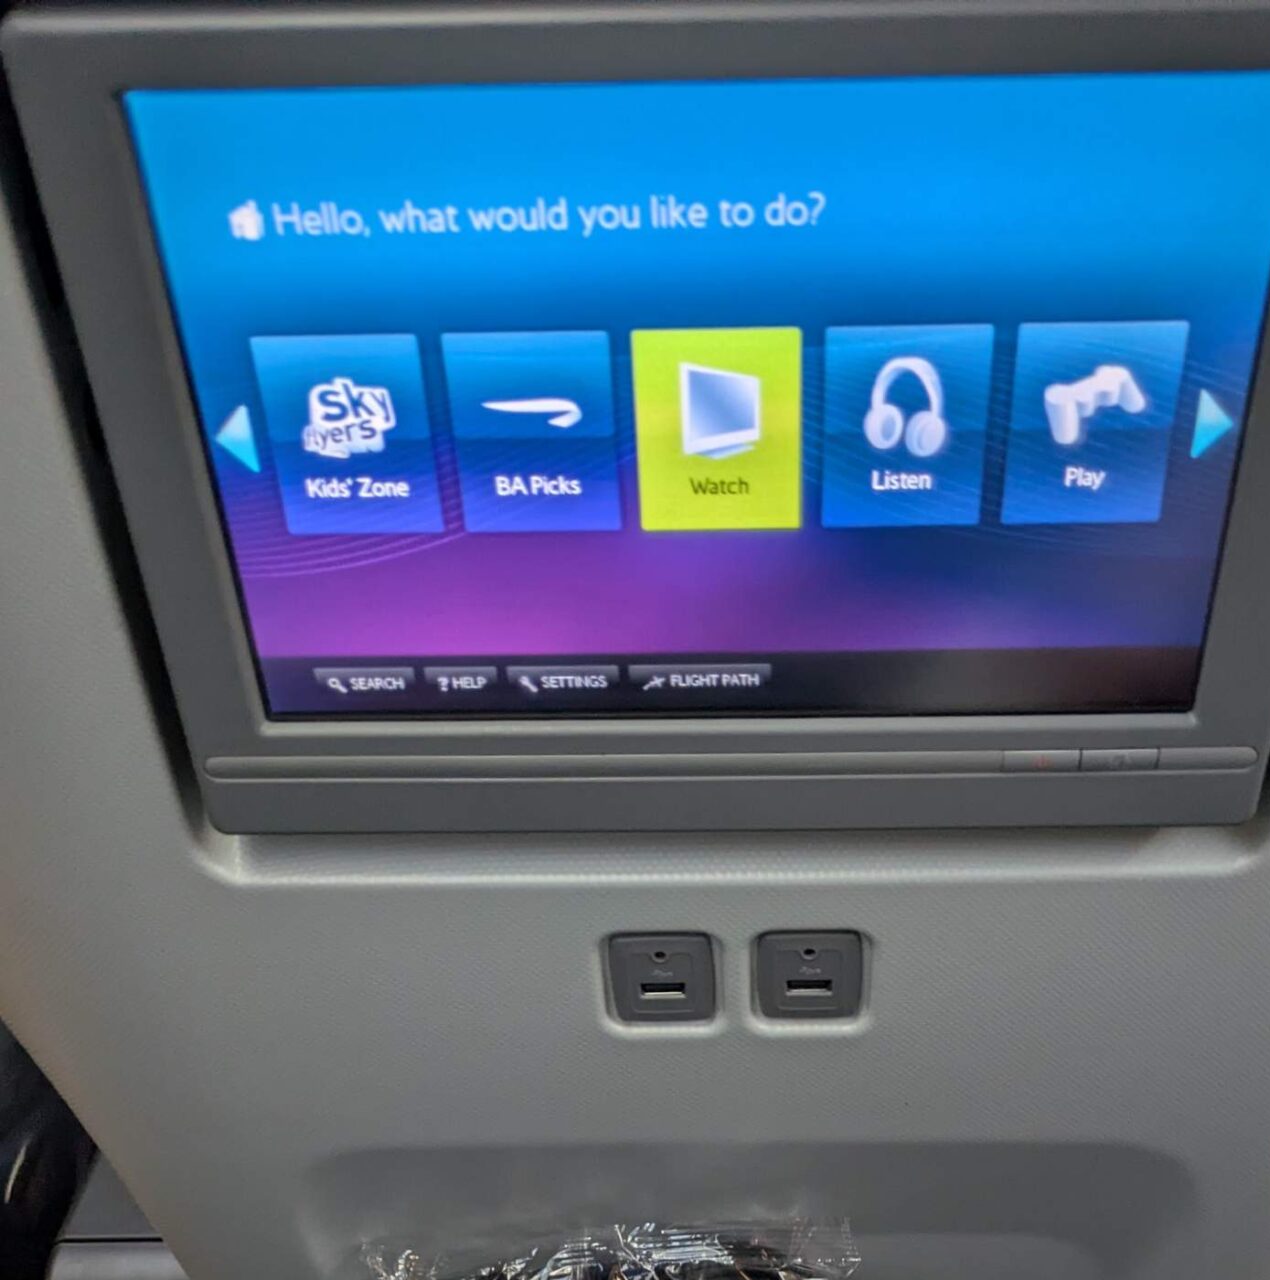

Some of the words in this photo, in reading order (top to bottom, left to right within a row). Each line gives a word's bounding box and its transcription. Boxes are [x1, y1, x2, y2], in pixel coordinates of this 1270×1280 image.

[272, 202, 371, 237] Hello,
[378, 200, 460, 233] what
[468, 196, 568, 232] would
[578, 203, 641, 238] you
[650, 194, 707, 228] like
[718, 199, 755, 228] to
[764, 191, 826, 226] do?
[304, 478, 353, 498] Kids'
[355, 477, 410, 498] Zone
[495, 476, 528, 496] BA
[530, 475, 581, 495] Picks
[689, 476, 749, 495] Watch
[871, 470, 933, 490] Listen
[1064, 466, 1105, 490] Play
[350, 677, 405, 691] SEARCH
[452, 676, 487, 690] HELP
[540, 675, 607, 688] SETTINGS
[670, 674, 719, 687] FLIGHT
[721, 673, 760, 686] PATH
